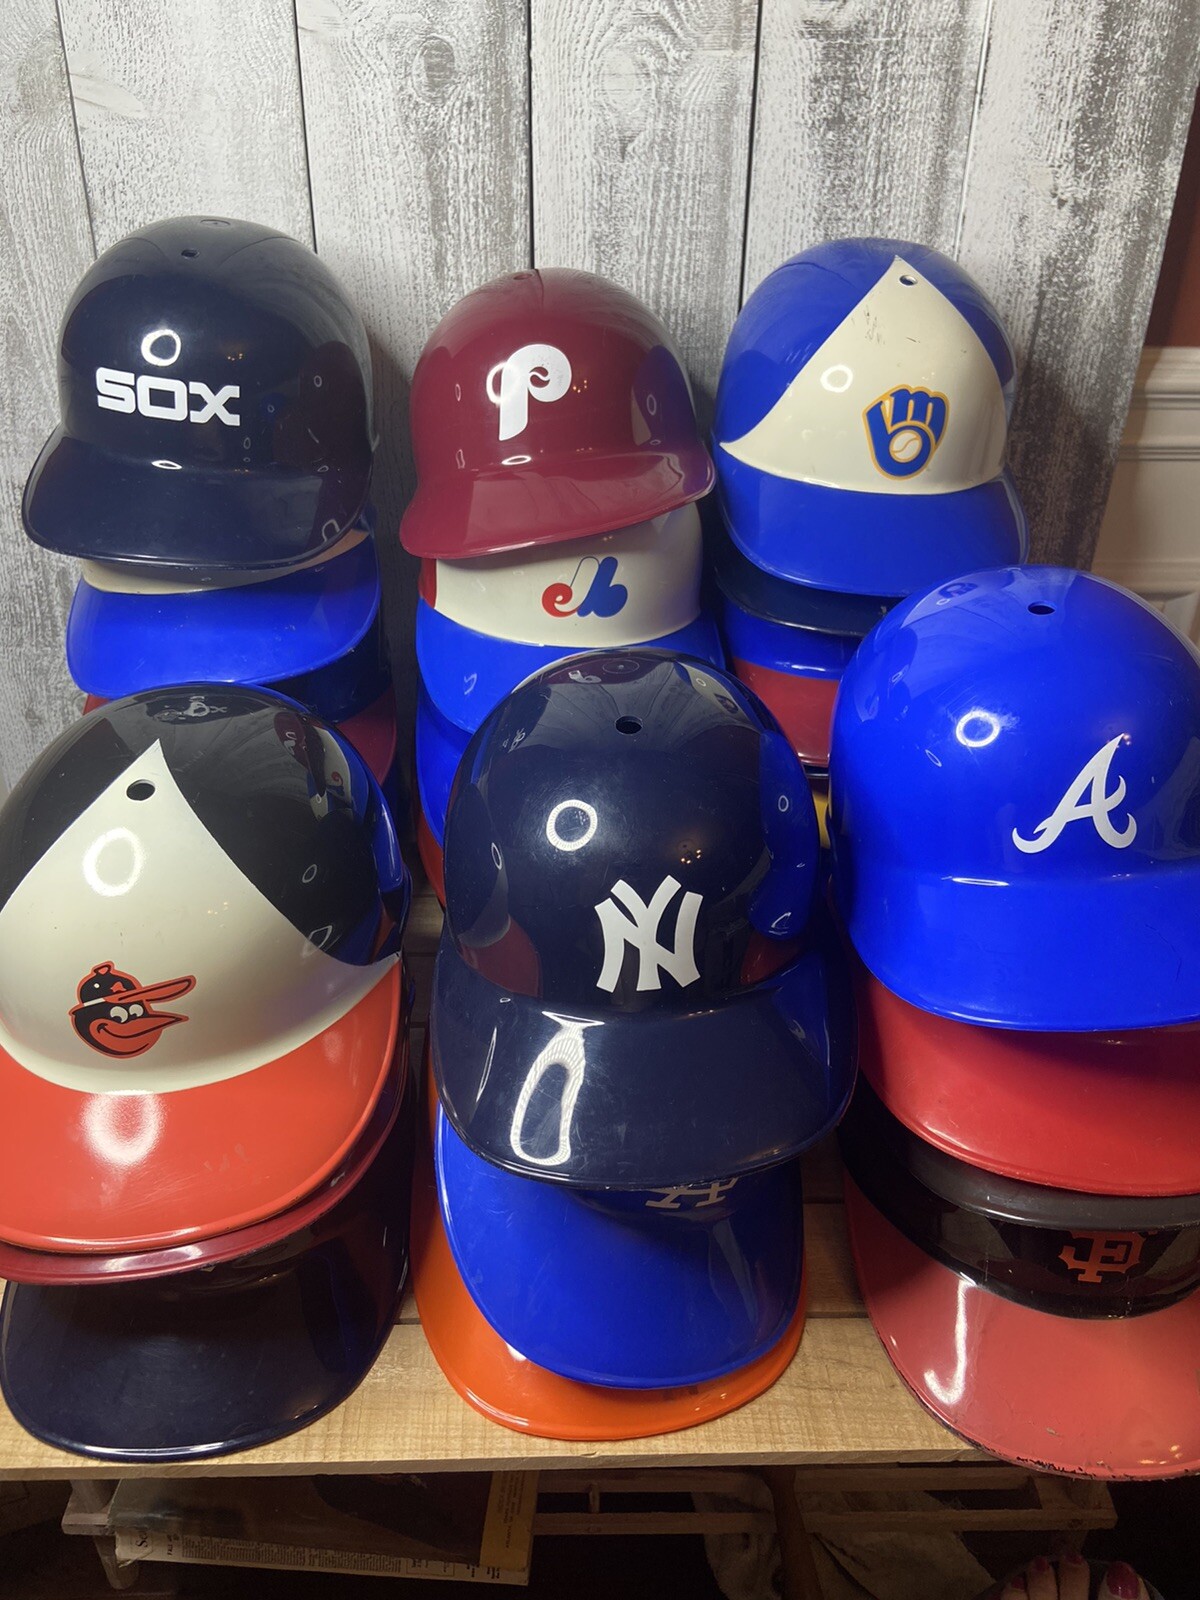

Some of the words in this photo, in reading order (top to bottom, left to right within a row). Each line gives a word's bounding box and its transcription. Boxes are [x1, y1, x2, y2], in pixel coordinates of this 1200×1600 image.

[96, 367, 240, 426] SOX
[499, 344, 572, 441] P
[1012, 733, 1137, 854] A
[594, 875, 703, 993] NY
